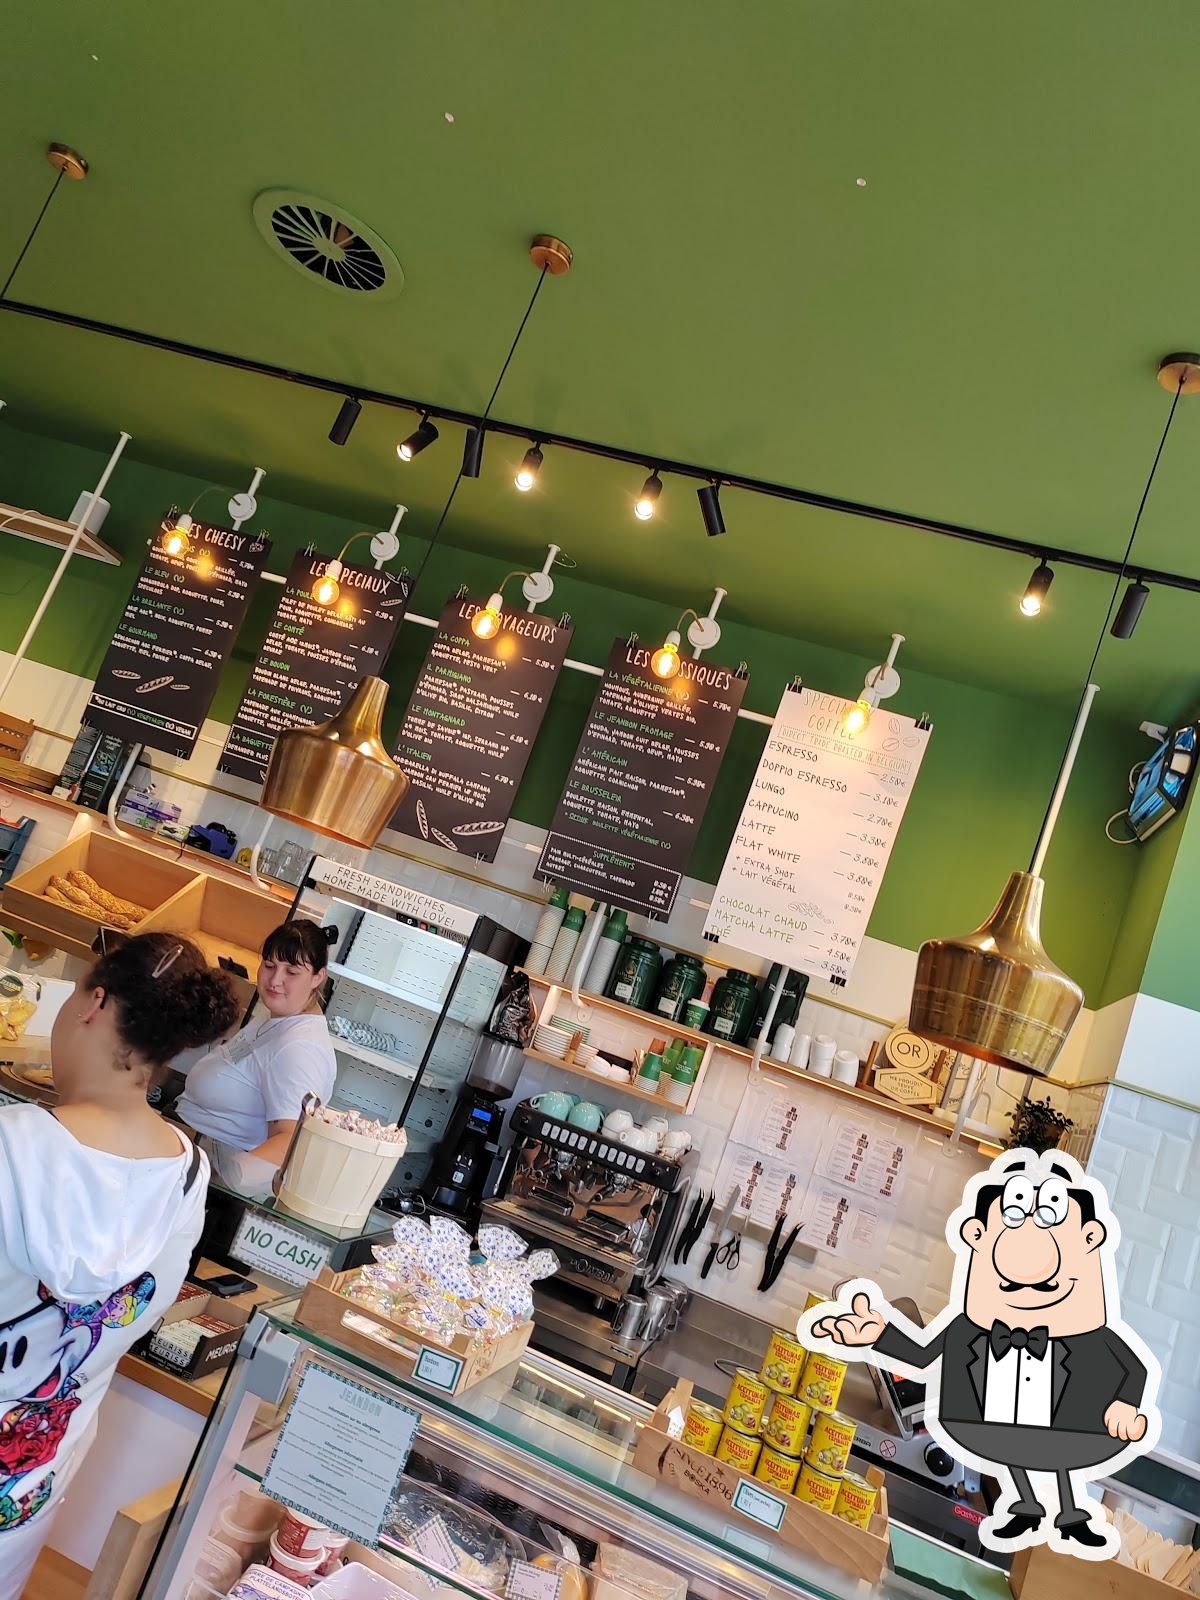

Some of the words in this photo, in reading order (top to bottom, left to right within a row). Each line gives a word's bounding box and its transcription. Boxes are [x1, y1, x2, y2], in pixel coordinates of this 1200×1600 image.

[202, 527, 246, 551] CHEESY
[127, 626, 158, 640] GOURMAND
[492, 611, 558, 643] OYAGEURS
[449, 635, 471, 646] COPPA
[269, 659, 290, 671] BOUDIN
[625, 645, 651, 668] LES
[433, 666, 473, 683] PARMIGIANO
[608, 670, 619, 680] LA
[620, 672, 674, 696] VÉGÉTALIENNE
[675, 690, 690, 701] (V)
[256, 688, 297, 709] FORESTIÈRE
[298, 704, 313, 715] (V)
[421, 707, 467, 727] MONTAGNARD
[593, 711, 604, 719] LE
[606, 714, 638, 730] JEANBON
[639, 724, 674, 740] FROMAGE
[241, 735, 273, 751] BAGUETTE
[404, 746, 432, 761] ITALIEN
[767, 739, 819, 762] ESPRESSO
[781, 728, 808, 742] DIRECT
[808, 735, 830, 748] TRADE
[864, 752, 874, 761] IN
[590, 746, 629, 766] AMÉRICAIN
[568, 779, 580, 788] LE
[761, 759, 794, 777] DOPPIO
[796, 769, 848, 793] ESPRESSO
[747, 798, 800, 822] CAPPUCINO
[754, 778, 786, 796] LUNGO
[866, 813, 894, 828] 2.70€
[740, 817, 776, 836] LATTE
[591, 849, 636, 870] SUPPLÉMENTS
[734, 834, 764, 852] FLAT
[766, 845, 800, 864] WHITE
[742, 856, 771, 872] EXTRA
[773, 866, 795, 880] SHOT
[337, 867, 371, 888] FRESH
[373, 879, 448, 914] SANDWICHES,
[739, 868, 757, 879] LAIT
[760, 872, 799, 894] VÉGÉTAL
[323, 874, 387, 903] HOME-MADE
[391, 898, 420, 915] WITH
[423, 908, 456, 927] LOVE!
[718, 894, 770, 920] CHOCOLAT
[773, 913, 808, 932] CHAUD
[710, 921, 731, 938] THÉ
[713, 909, 755, 931] MATCHA
[758, 924, 794, 944] LATTE
[896, 1042, 921, 1059] OR
[244, 1226, 274, 1249] NO
[274, 1240, 322, 1271] CASH
[684, 1470, 710, 1496] BOSKA
[704, 1472, 733, 1500] 1896
